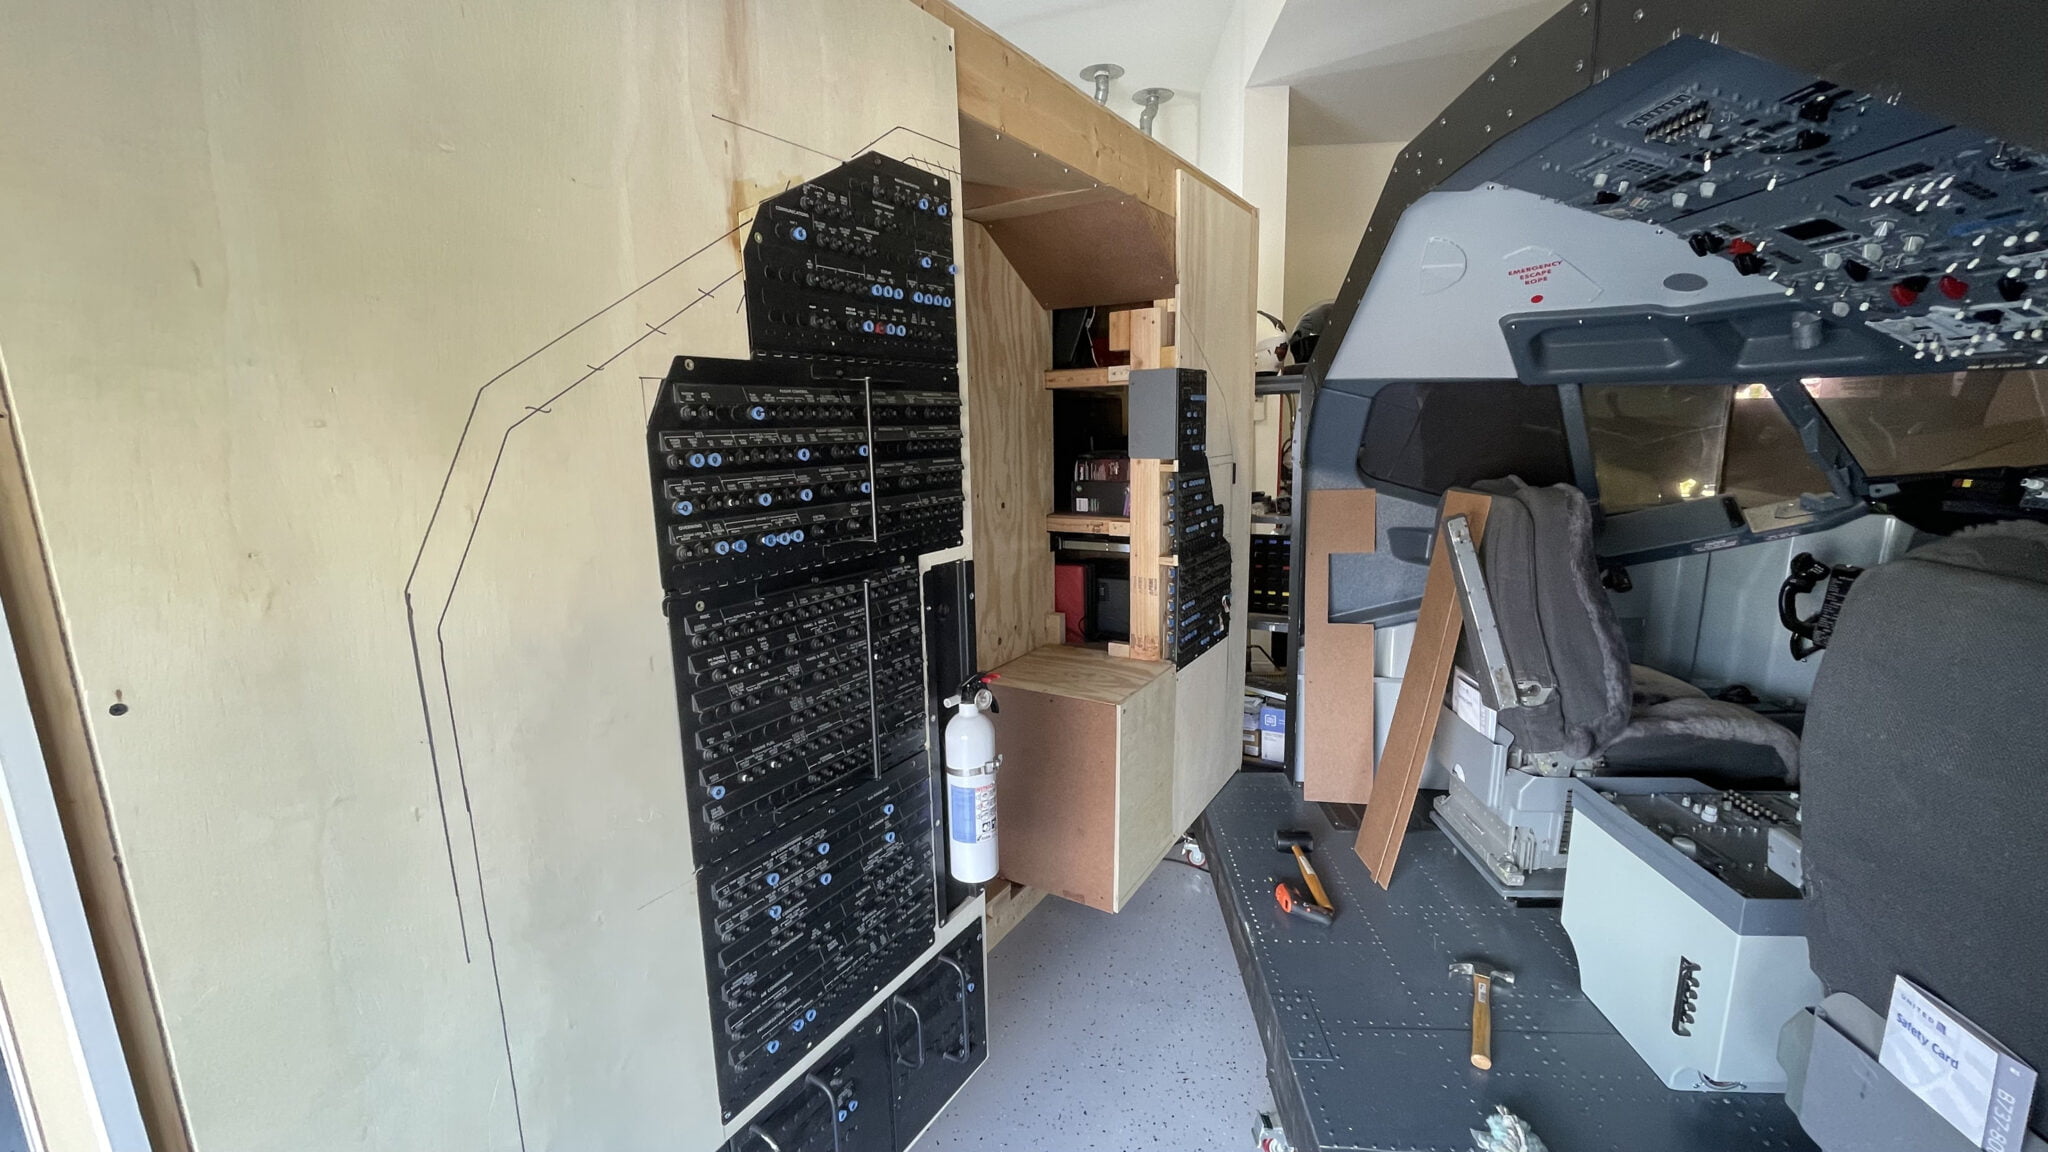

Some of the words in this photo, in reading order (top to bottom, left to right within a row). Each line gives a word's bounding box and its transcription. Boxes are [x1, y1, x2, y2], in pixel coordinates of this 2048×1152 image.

[1508, 260, 1563, 276] EMERGENCY
[1520, 269, 1552, 280] ESCAPE
[1524, 276, 1548, 285] ROPE
[1900, 992, 1935, 1025] UNITED
[1896, 1012, 1930, 1046] Safety
[1931, 1042, 1959, 1070] Card
